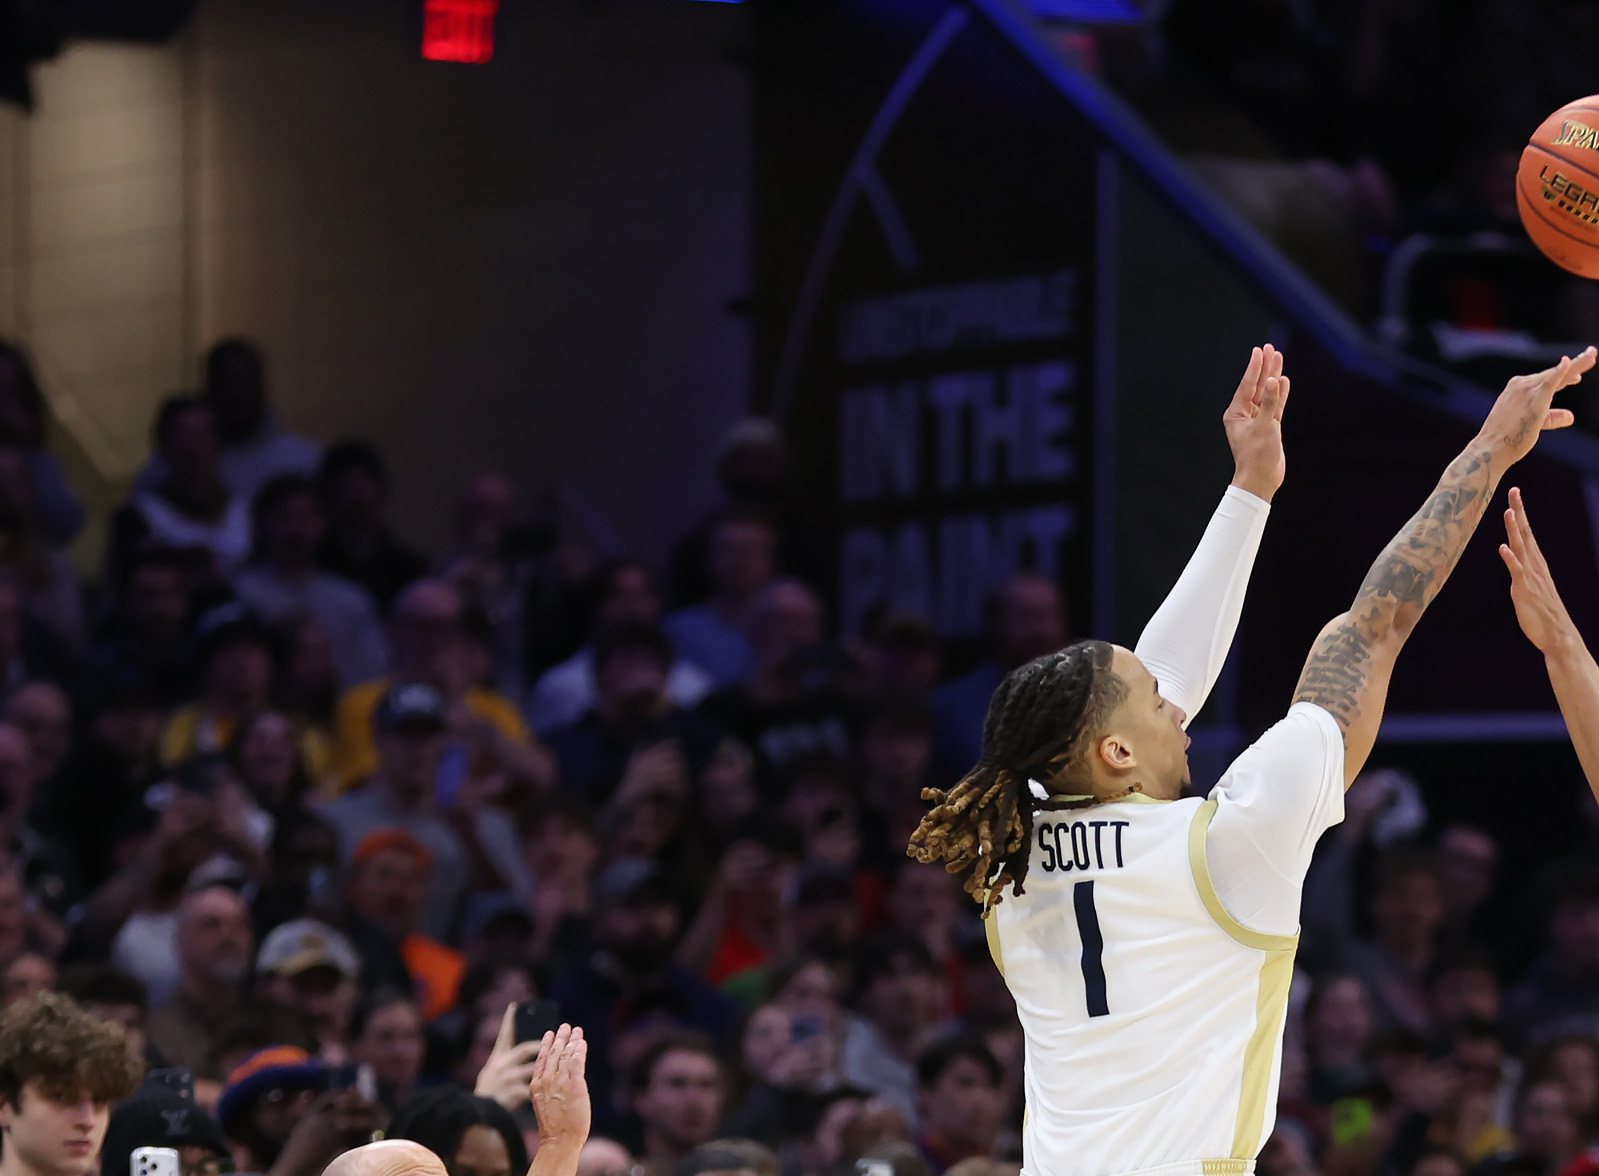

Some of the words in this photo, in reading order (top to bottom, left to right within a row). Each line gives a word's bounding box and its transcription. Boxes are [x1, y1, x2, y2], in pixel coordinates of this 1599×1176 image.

[838, 269, 1079, 366] UNSTOPPABLE
[926, 358, 1079, 496] THE
[1038, 821, 1130, 872] SCOTT
[1073, 880, 1110, 1017] 1
